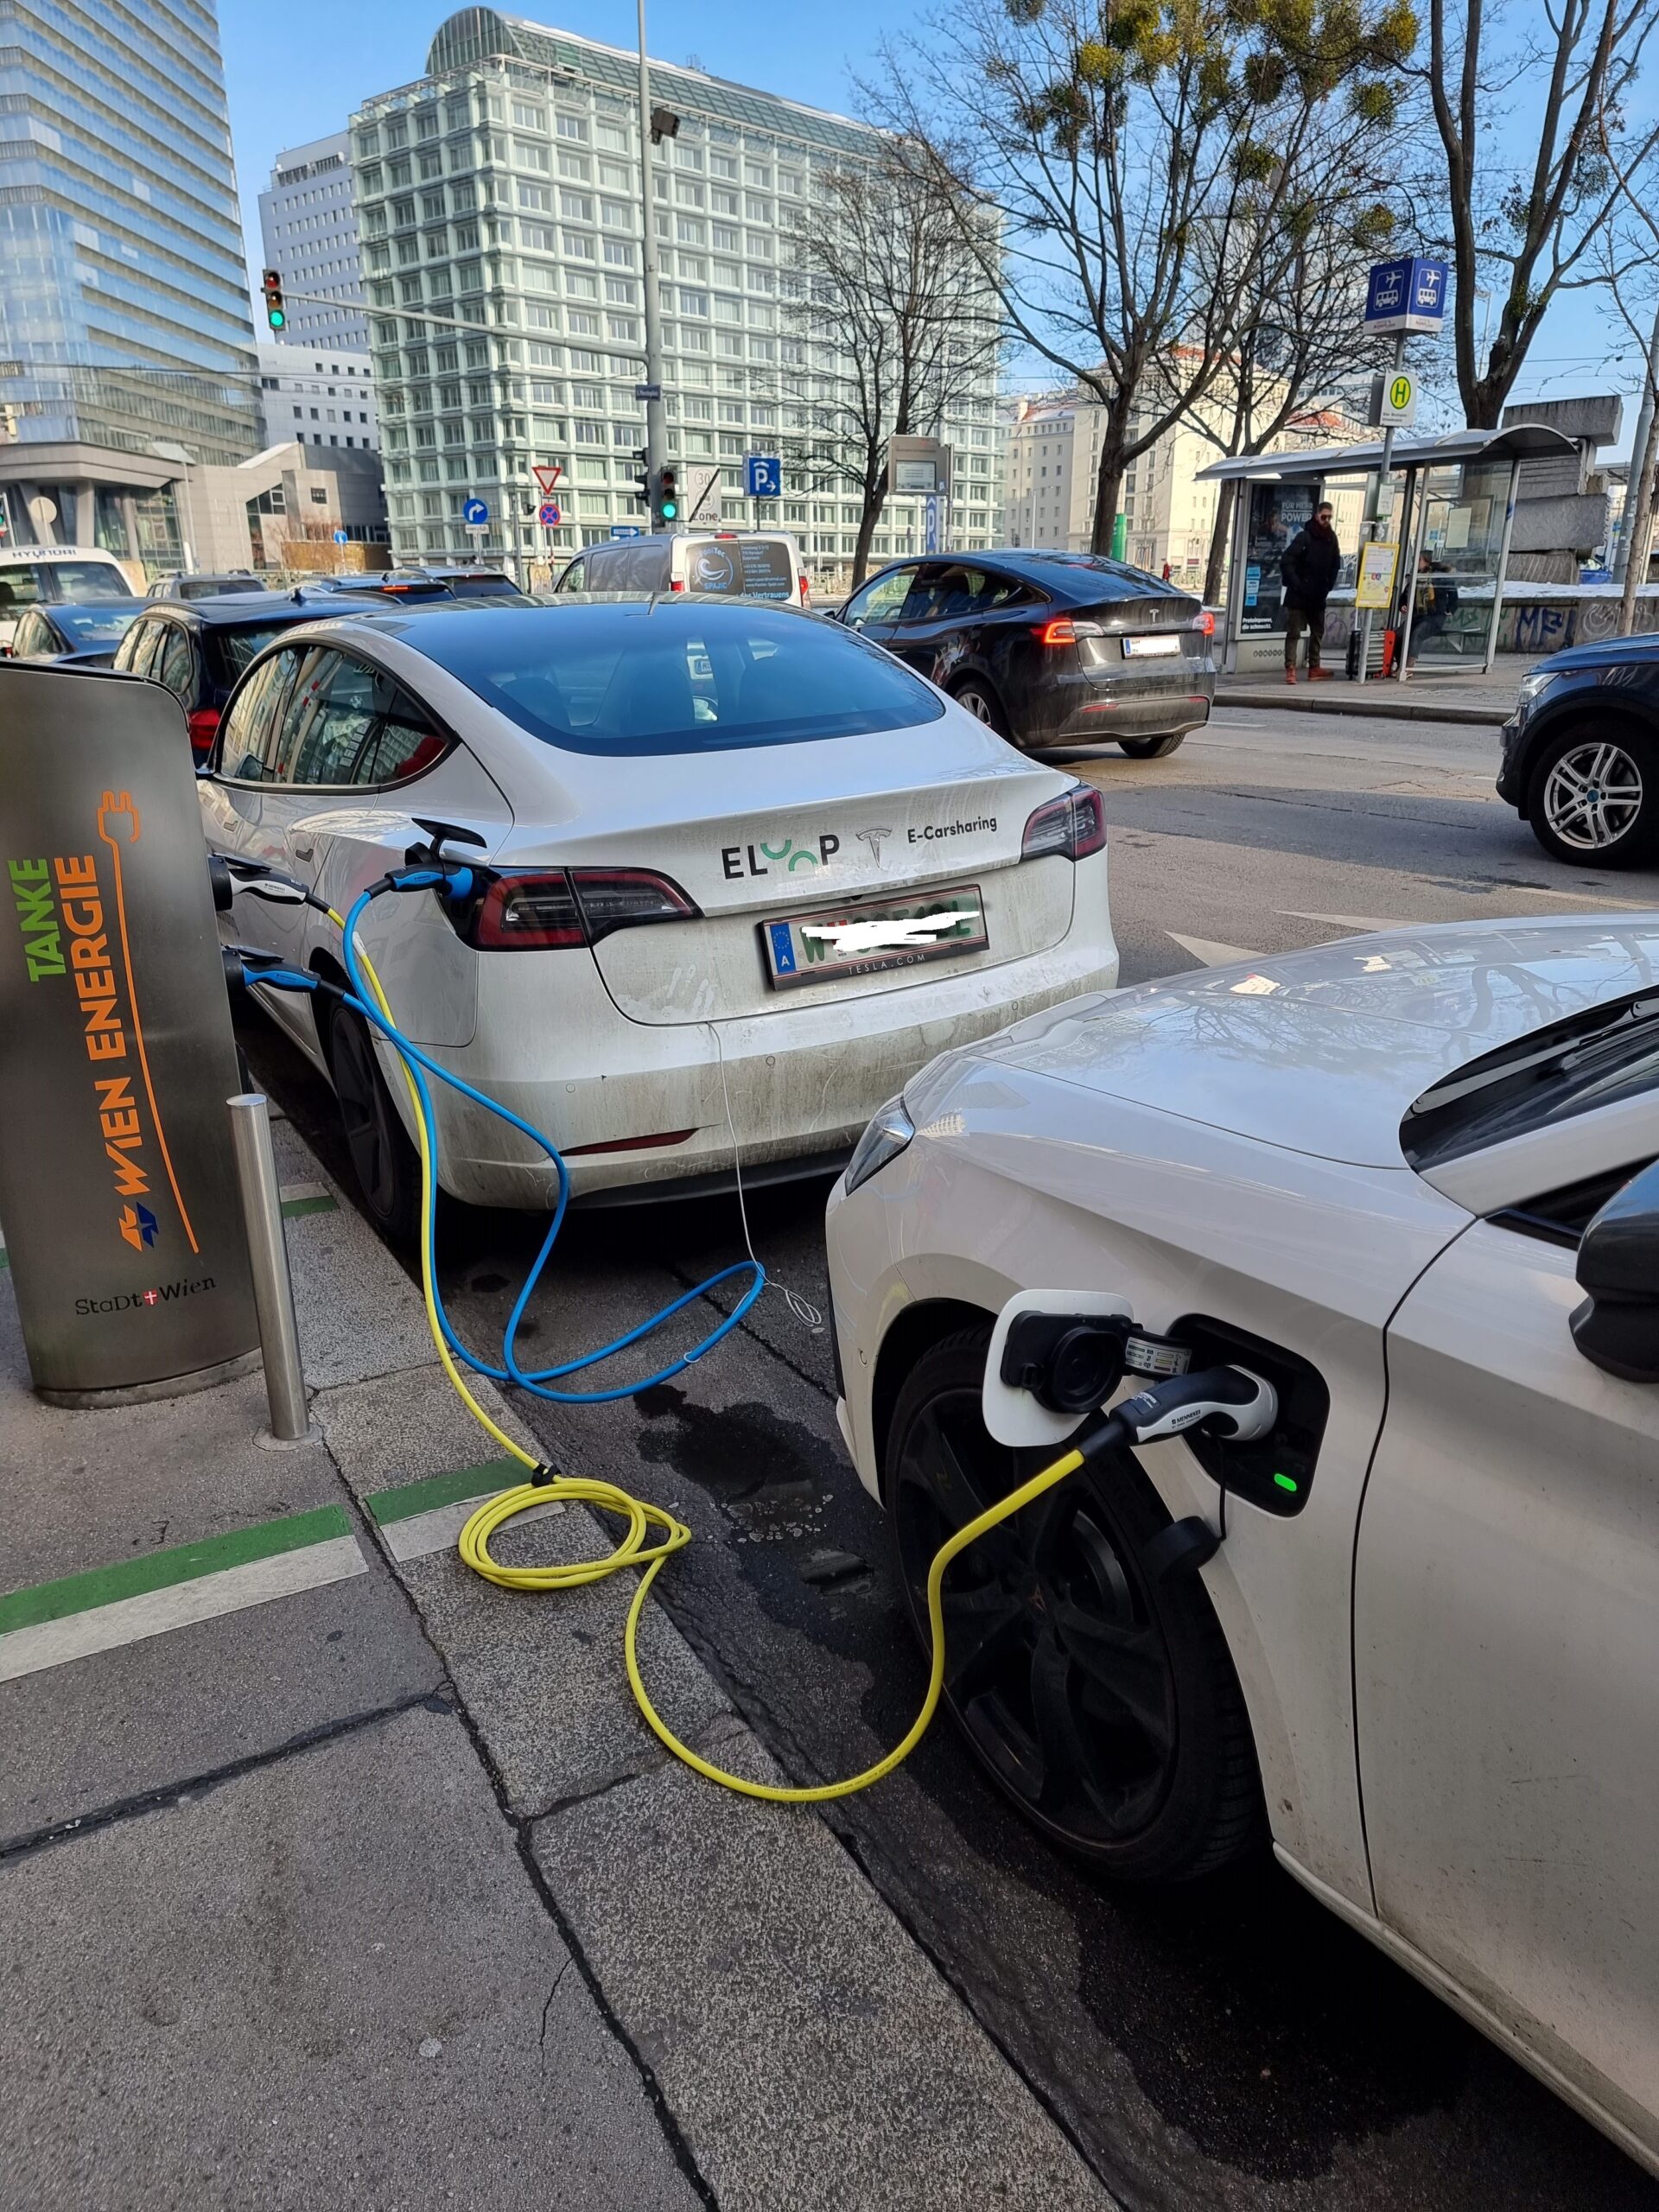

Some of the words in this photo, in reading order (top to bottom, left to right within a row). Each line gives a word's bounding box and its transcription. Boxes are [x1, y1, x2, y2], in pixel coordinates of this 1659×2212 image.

[1395, 383, 1406, 403] H
[698, 473, 709, 485] 30
[755, 468, 768, 491] P
[908, 817, 997, 843] E-Carsharing
[8, 858, 67, 982] TANKE
[54, 855, 127, 1061] ENERGIE
[781, 955, 790, 967] A
[849, 953, 925, 975] TESLA.COM
[94, 1077, 150, 1197] WIEN
[159, 1277, 216, 1301] Wien
